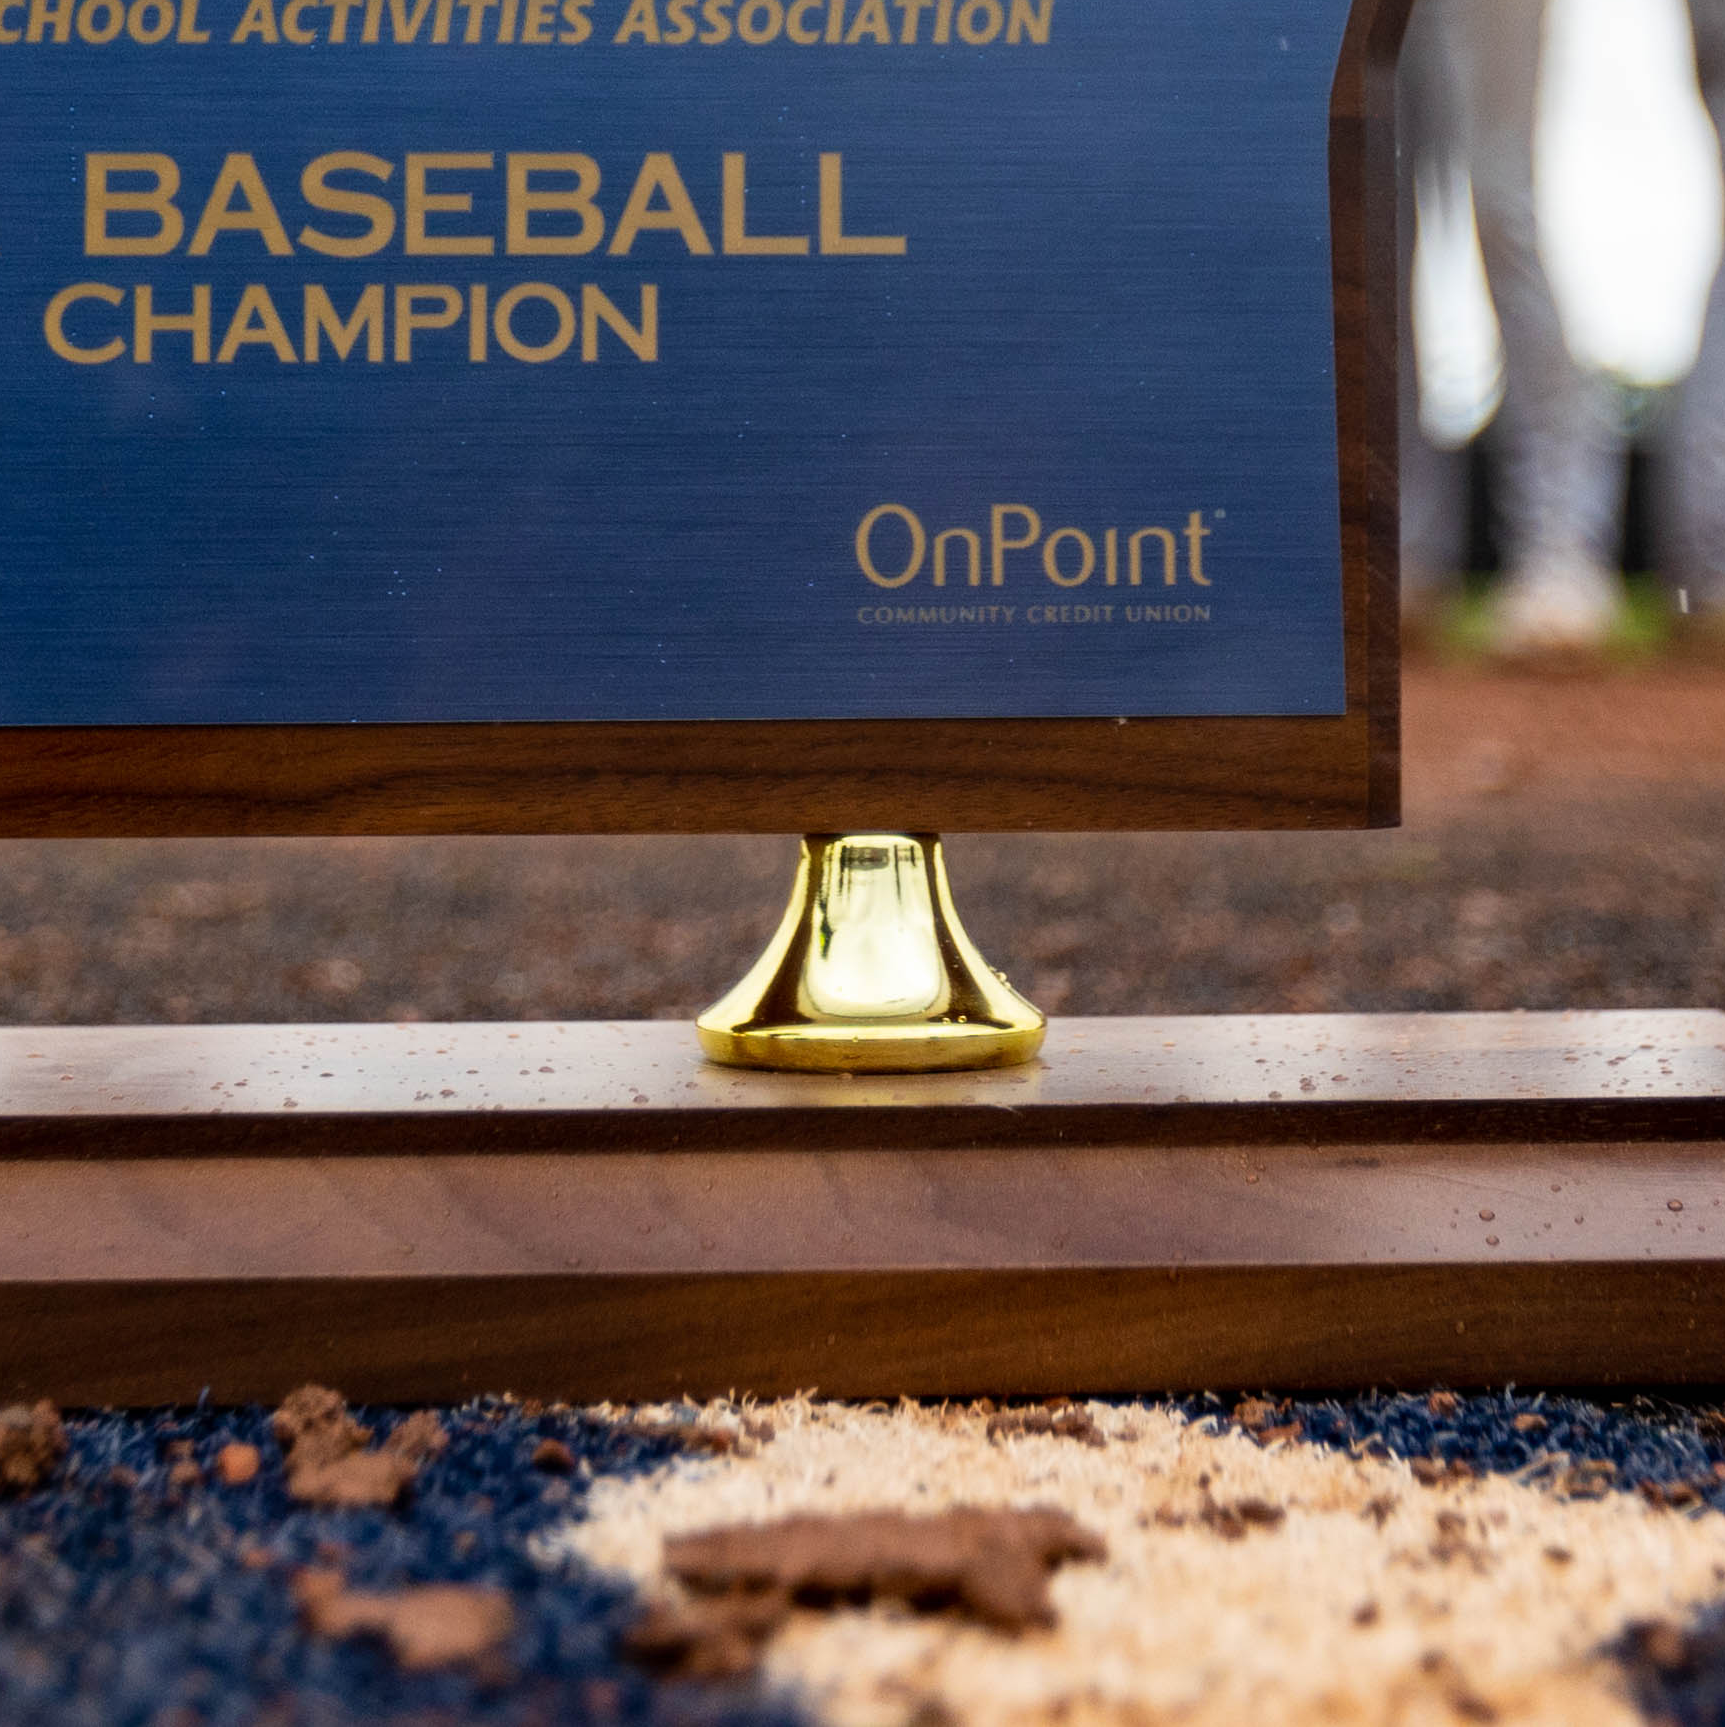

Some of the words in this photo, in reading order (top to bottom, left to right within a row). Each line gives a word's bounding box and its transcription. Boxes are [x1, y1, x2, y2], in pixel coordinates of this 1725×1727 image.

[82, 151, 908, 258] BASEBALL
[43, 282, 660, 365] CHAMPION
[855, 503, 1212, 589] OnPoint
[856, 606, 1016, 624] COMMUNITY
[1026, 605, 1115, 624] CREDIT
[1124, 604, 1212, 624] UNION
